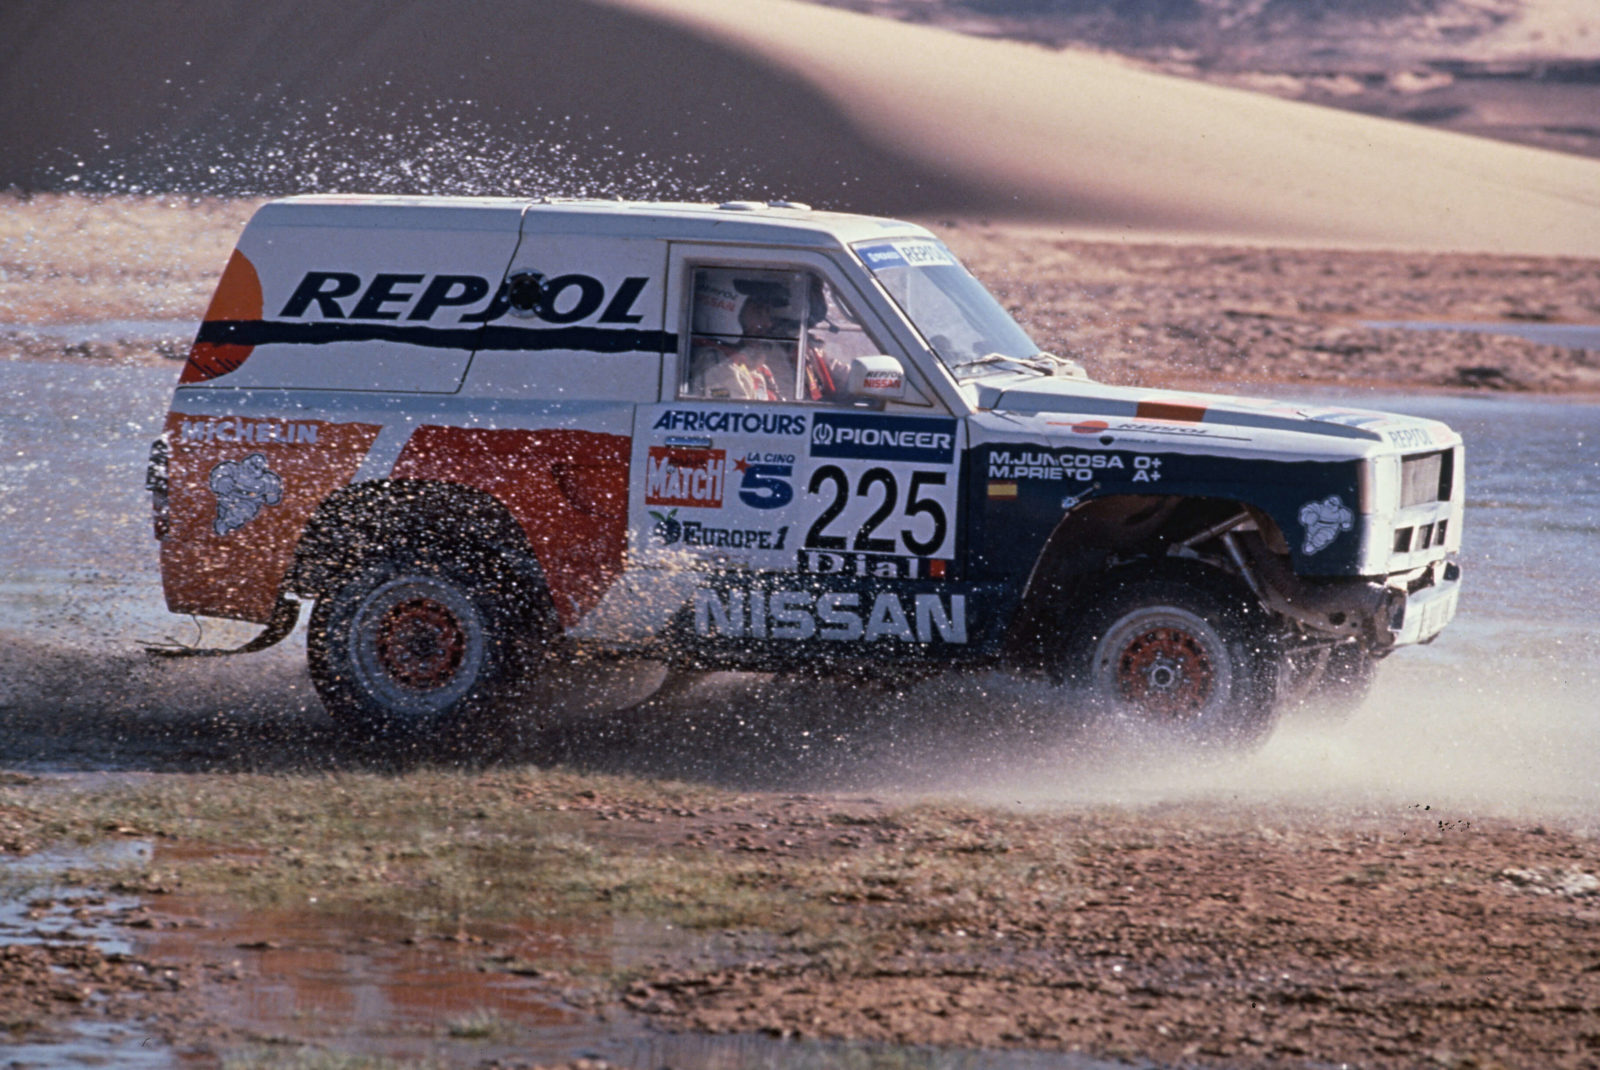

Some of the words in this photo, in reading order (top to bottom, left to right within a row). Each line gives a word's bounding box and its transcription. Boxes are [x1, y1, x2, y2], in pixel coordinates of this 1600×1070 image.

[864, 379, 901, 388] NISSAN
[181, 420, 318, 444] MICHELIN
[653, 410, 806, 435] AFRICATOURS
[836, 427, 951, 449] PIONEER
[747, 452, 761, 461] LA
[764, 453, 795, 464] CINQ
[989, 451, 1124, 469] M.JUNCOSA
[648, 455, 724, 501] MATCH
[988, 465, 1093, 481] M.PRIETO
[1132, 470, 1161, 482] A+
[738, 464, 793, 509] 5
[805, 465, 947, 556] 225
[806, 551, 919, 578] Dial
[695, 588, 967, 643] NISSAN
